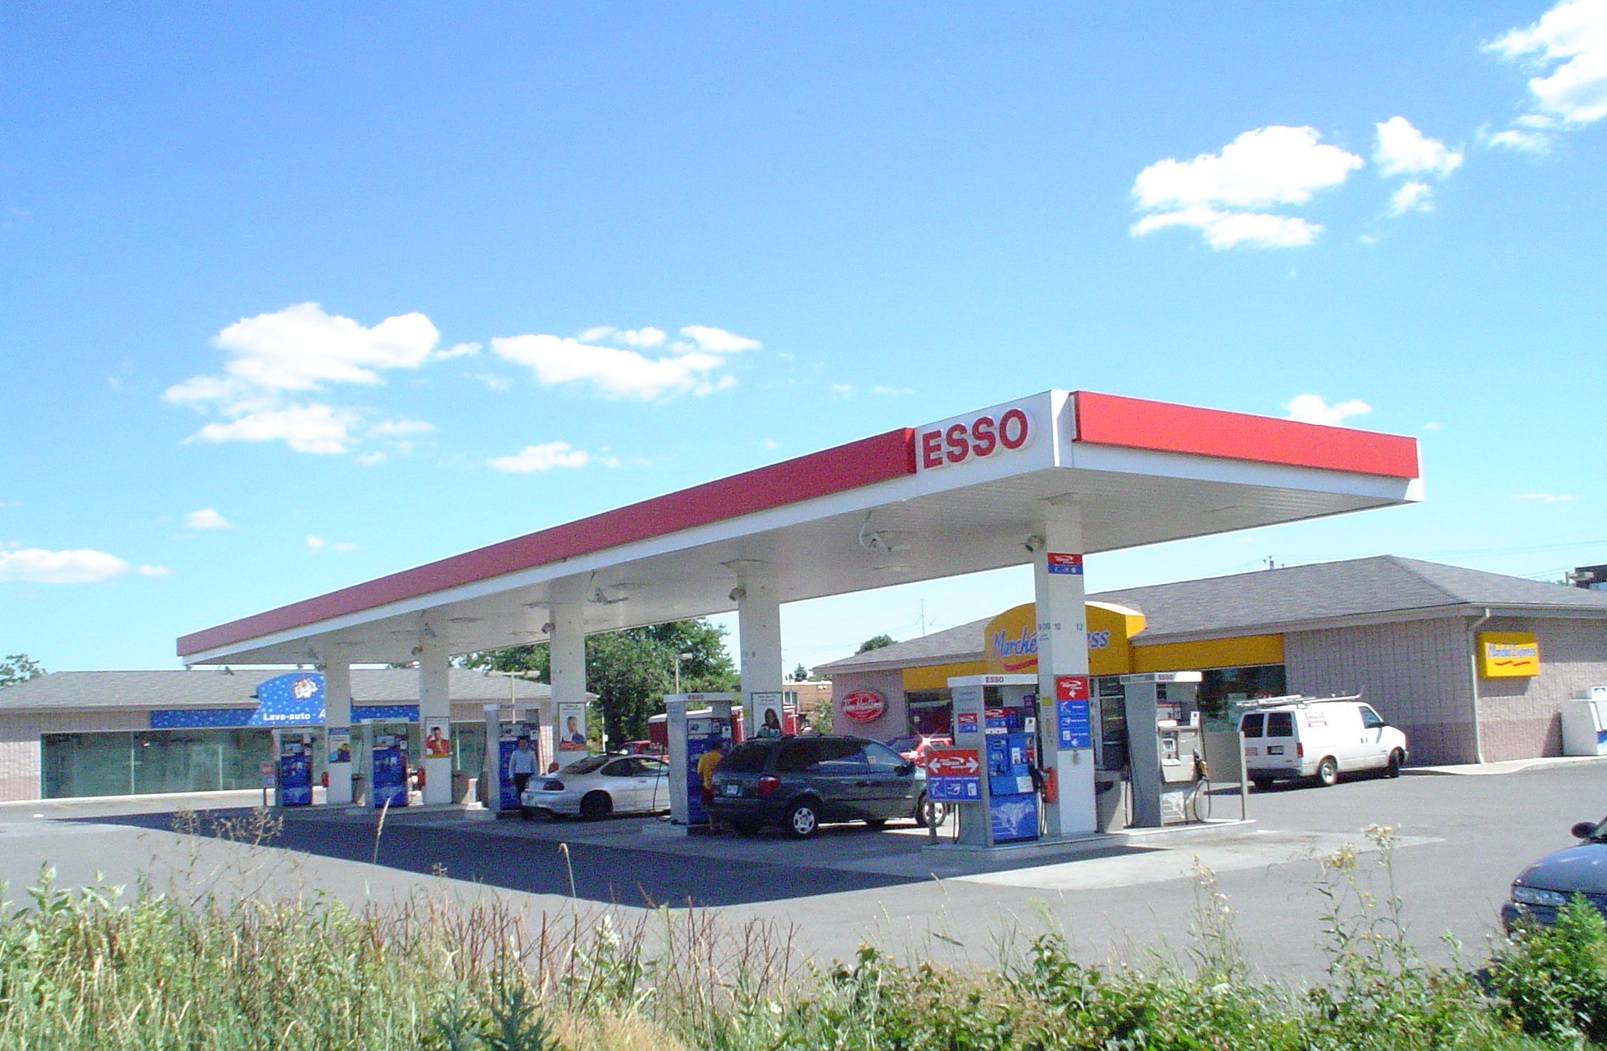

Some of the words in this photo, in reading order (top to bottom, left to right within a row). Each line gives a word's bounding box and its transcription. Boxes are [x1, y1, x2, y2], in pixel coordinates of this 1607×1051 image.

[922, 408, 1028, 469] ESSO
[994, 628, 1038, 657] Marché
[263, 712, 311, 721] Lave-auto
